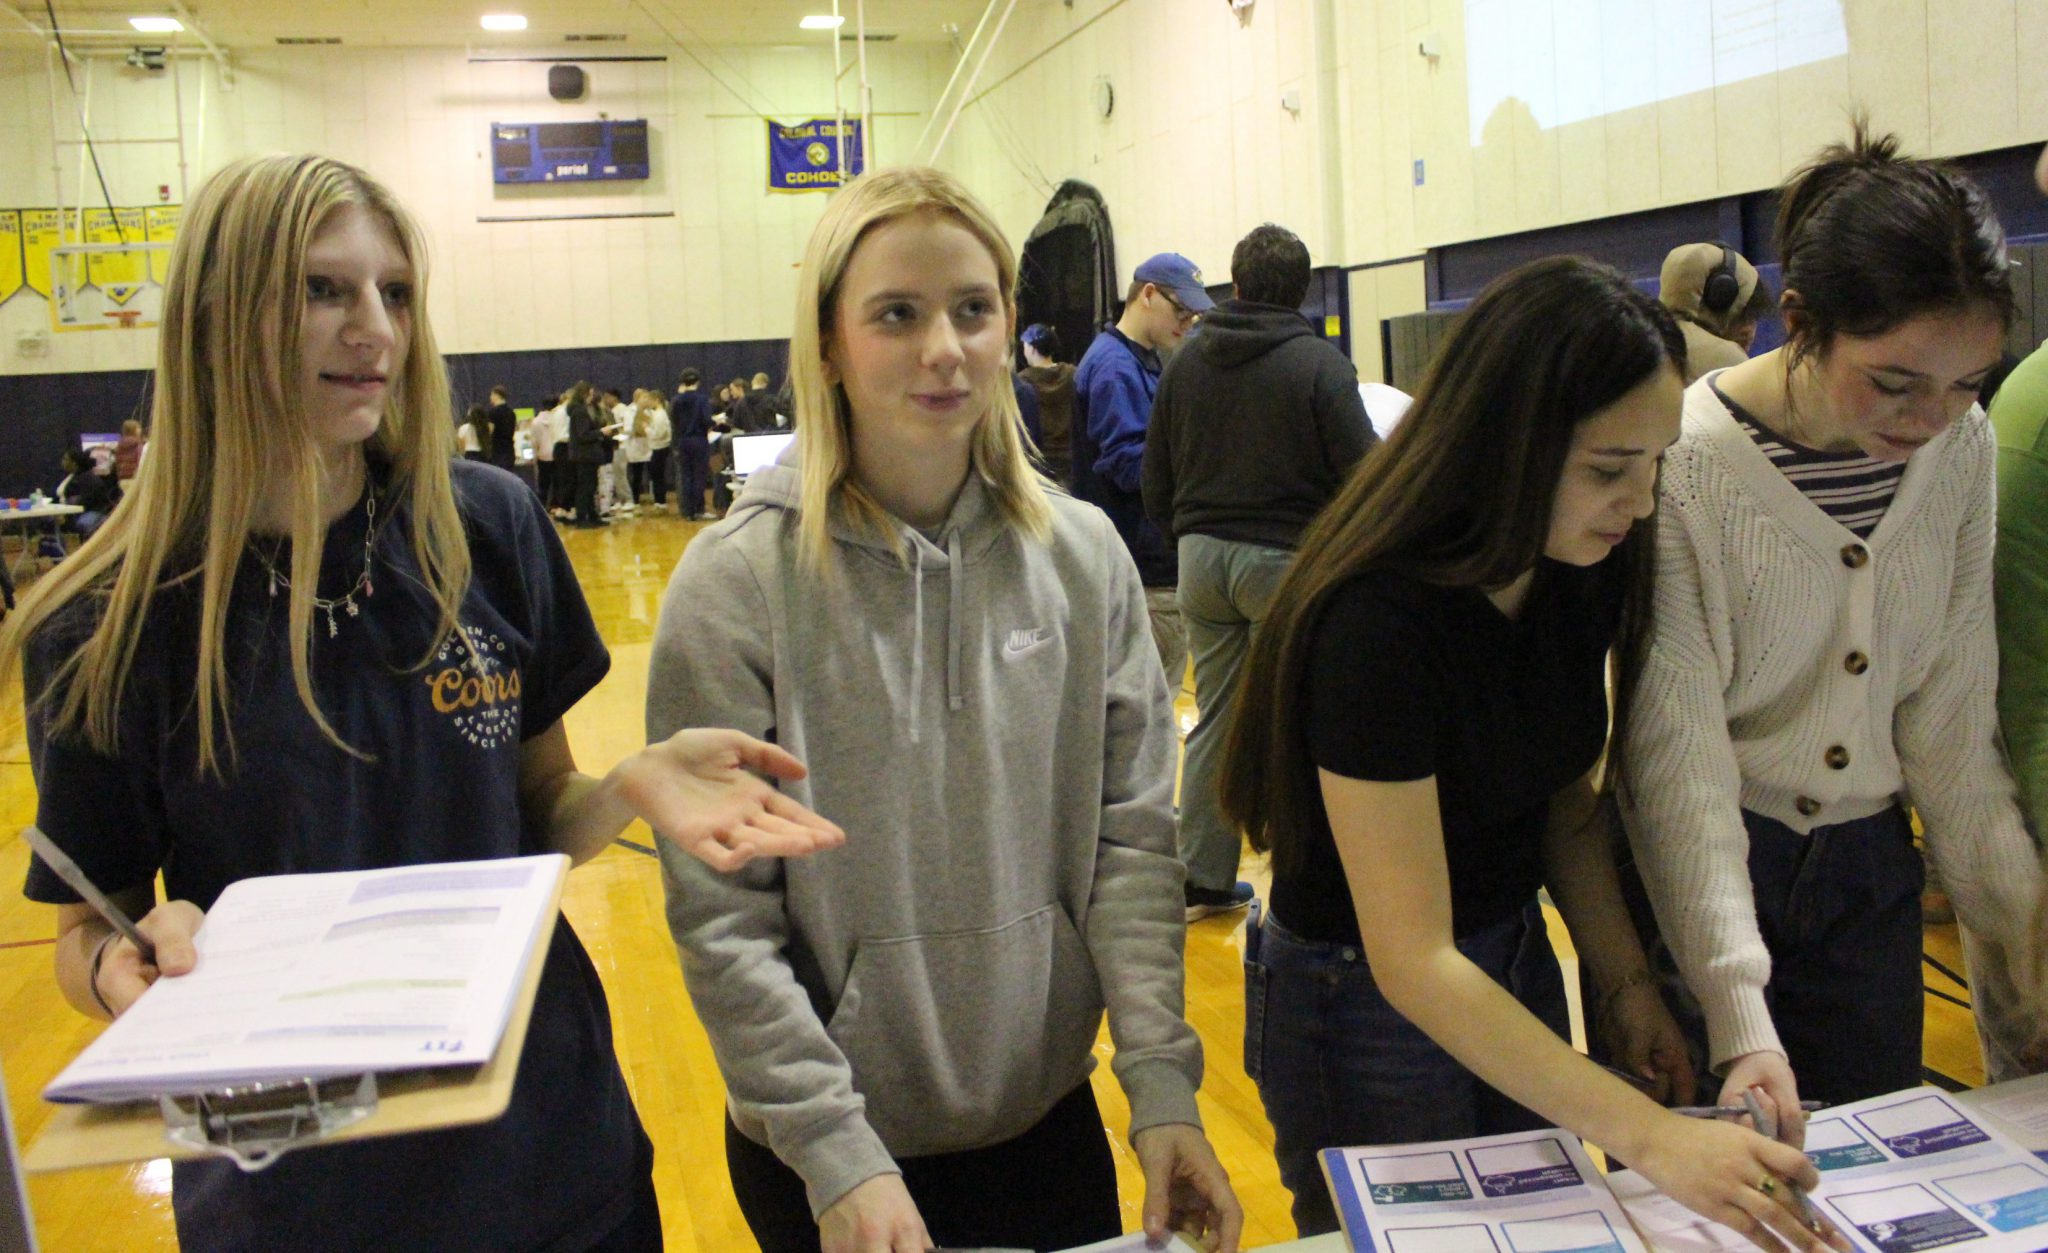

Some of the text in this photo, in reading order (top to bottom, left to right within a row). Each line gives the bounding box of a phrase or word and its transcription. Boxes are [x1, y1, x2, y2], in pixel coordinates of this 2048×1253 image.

[557, 163, 588, 177] period
[455, 639, 489, 656] BER
[425, 668, 522, 713] Coors
[481, 709, 500, 719] THE
[454, 717, 496, 748] SINCE
